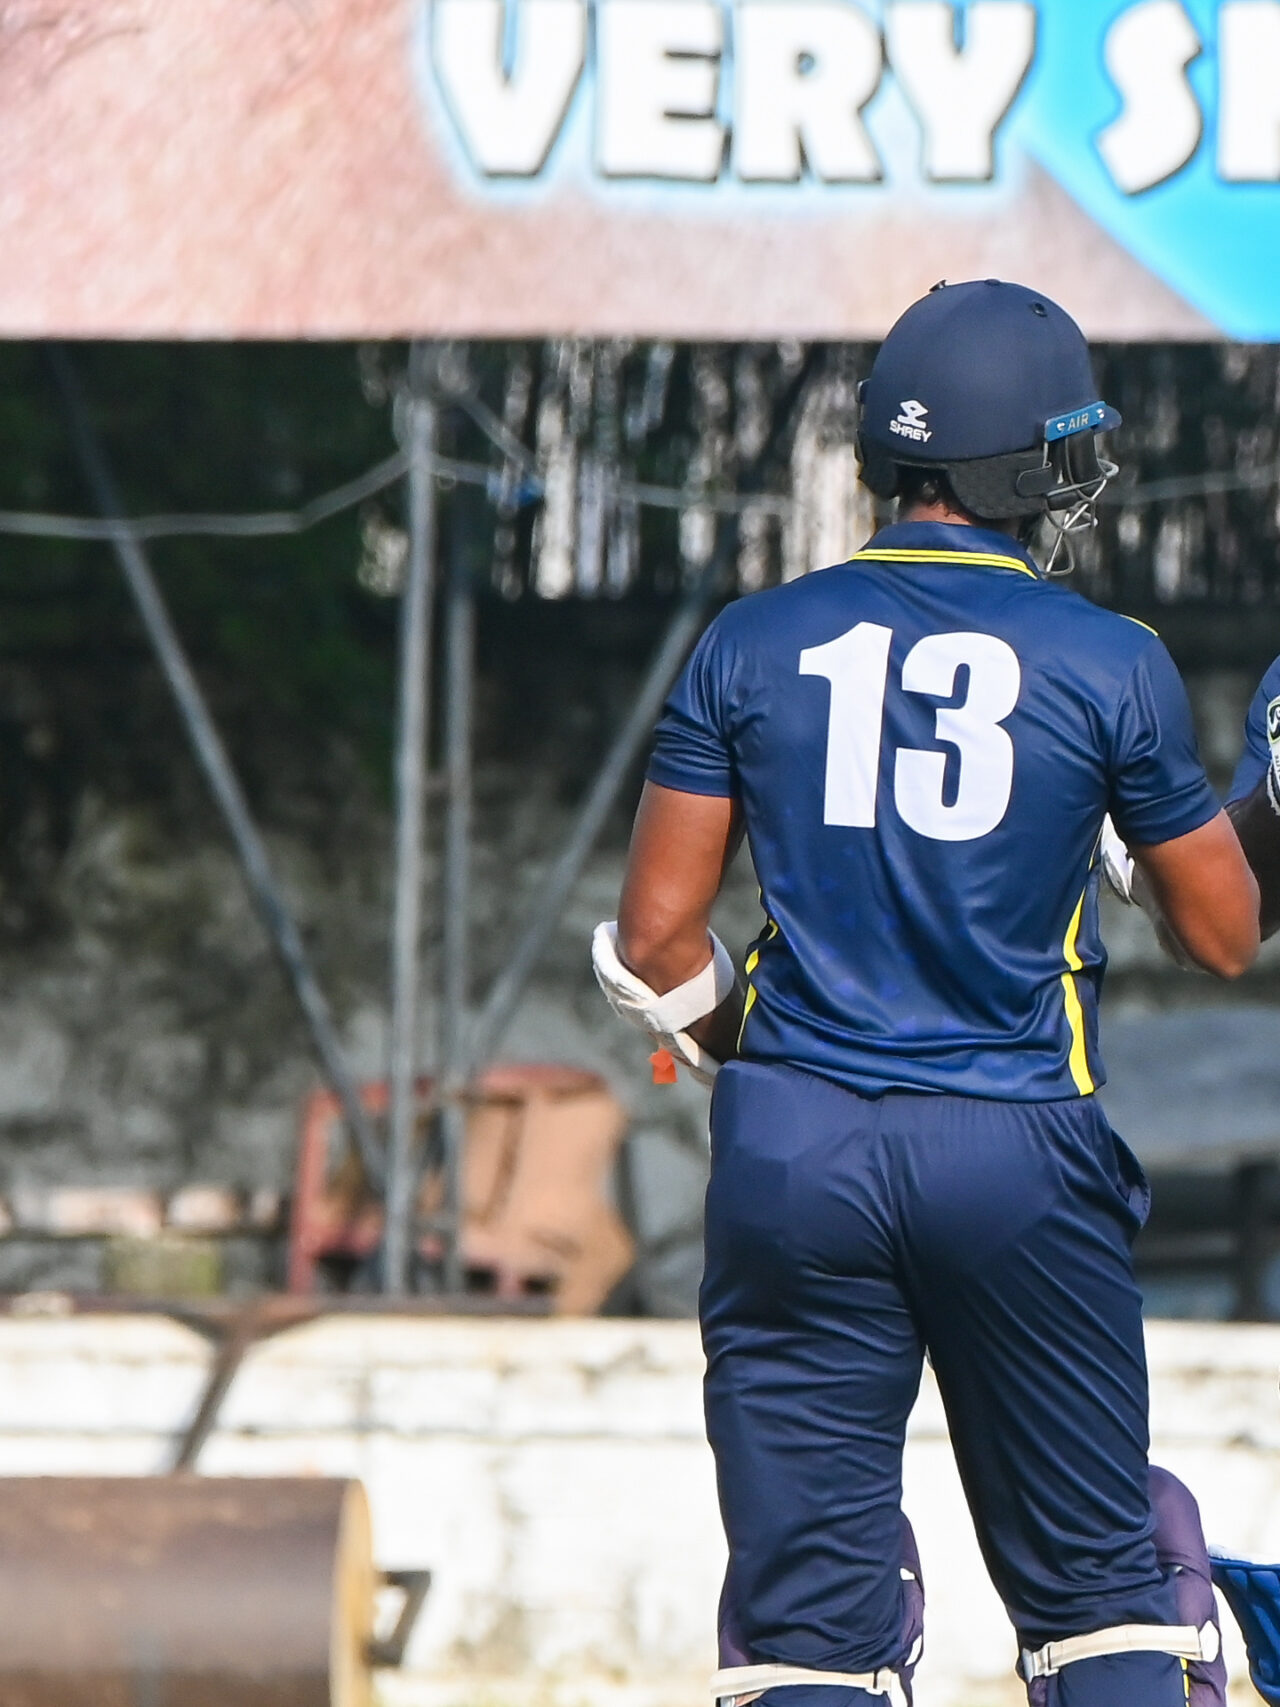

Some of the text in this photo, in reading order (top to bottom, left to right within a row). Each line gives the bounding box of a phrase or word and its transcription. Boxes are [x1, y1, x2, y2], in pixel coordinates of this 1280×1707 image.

[430, 0, 1037, 183] VERY
[889, 420, 932, 443] SHREY
[1067, 412, 1089, 432] AIR
[798, 621, 1022, 842] 13
